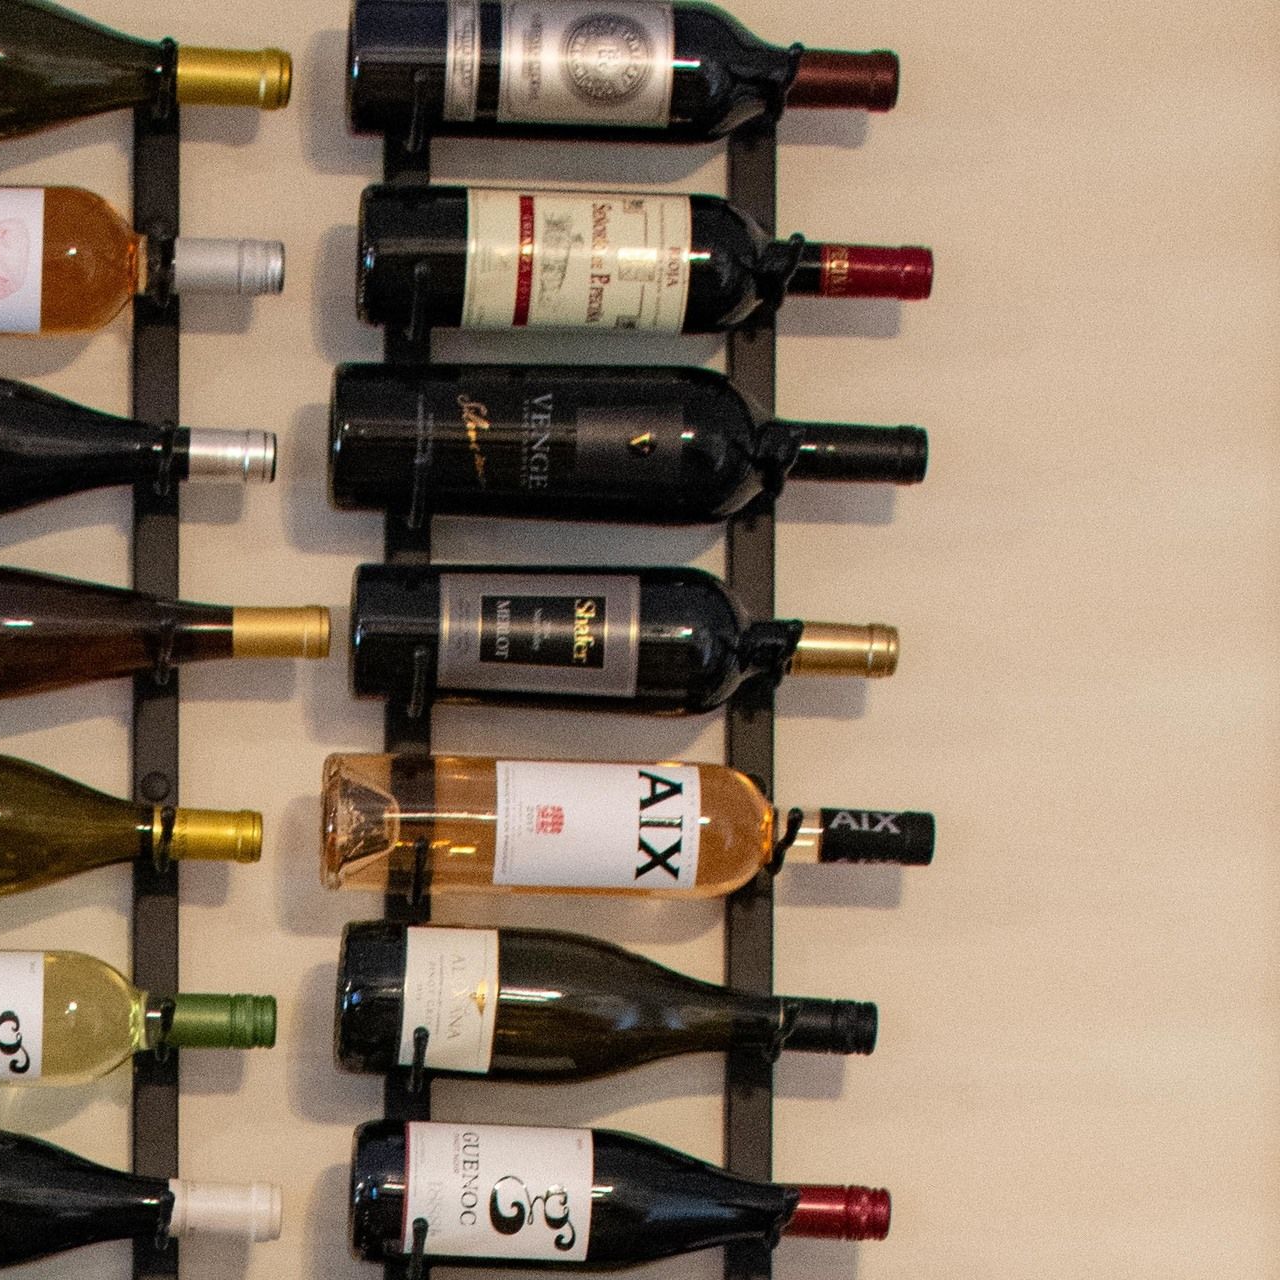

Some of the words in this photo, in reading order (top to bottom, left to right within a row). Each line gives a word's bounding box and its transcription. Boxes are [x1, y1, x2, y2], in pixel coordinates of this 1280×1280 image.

[667, 247, 681, 287] ROJA
[527, 393, 553, 490] VENGE
[494, 600, 511, 659] MERLOT
[572, 599, 597, 664] Shafer
[636, 769, 684, 882] AIX
[829, 811, 902, 834] AIX
[448, 953, 467, 1040] ALANA
[460, 1131, 481, 1227] GUENOC
